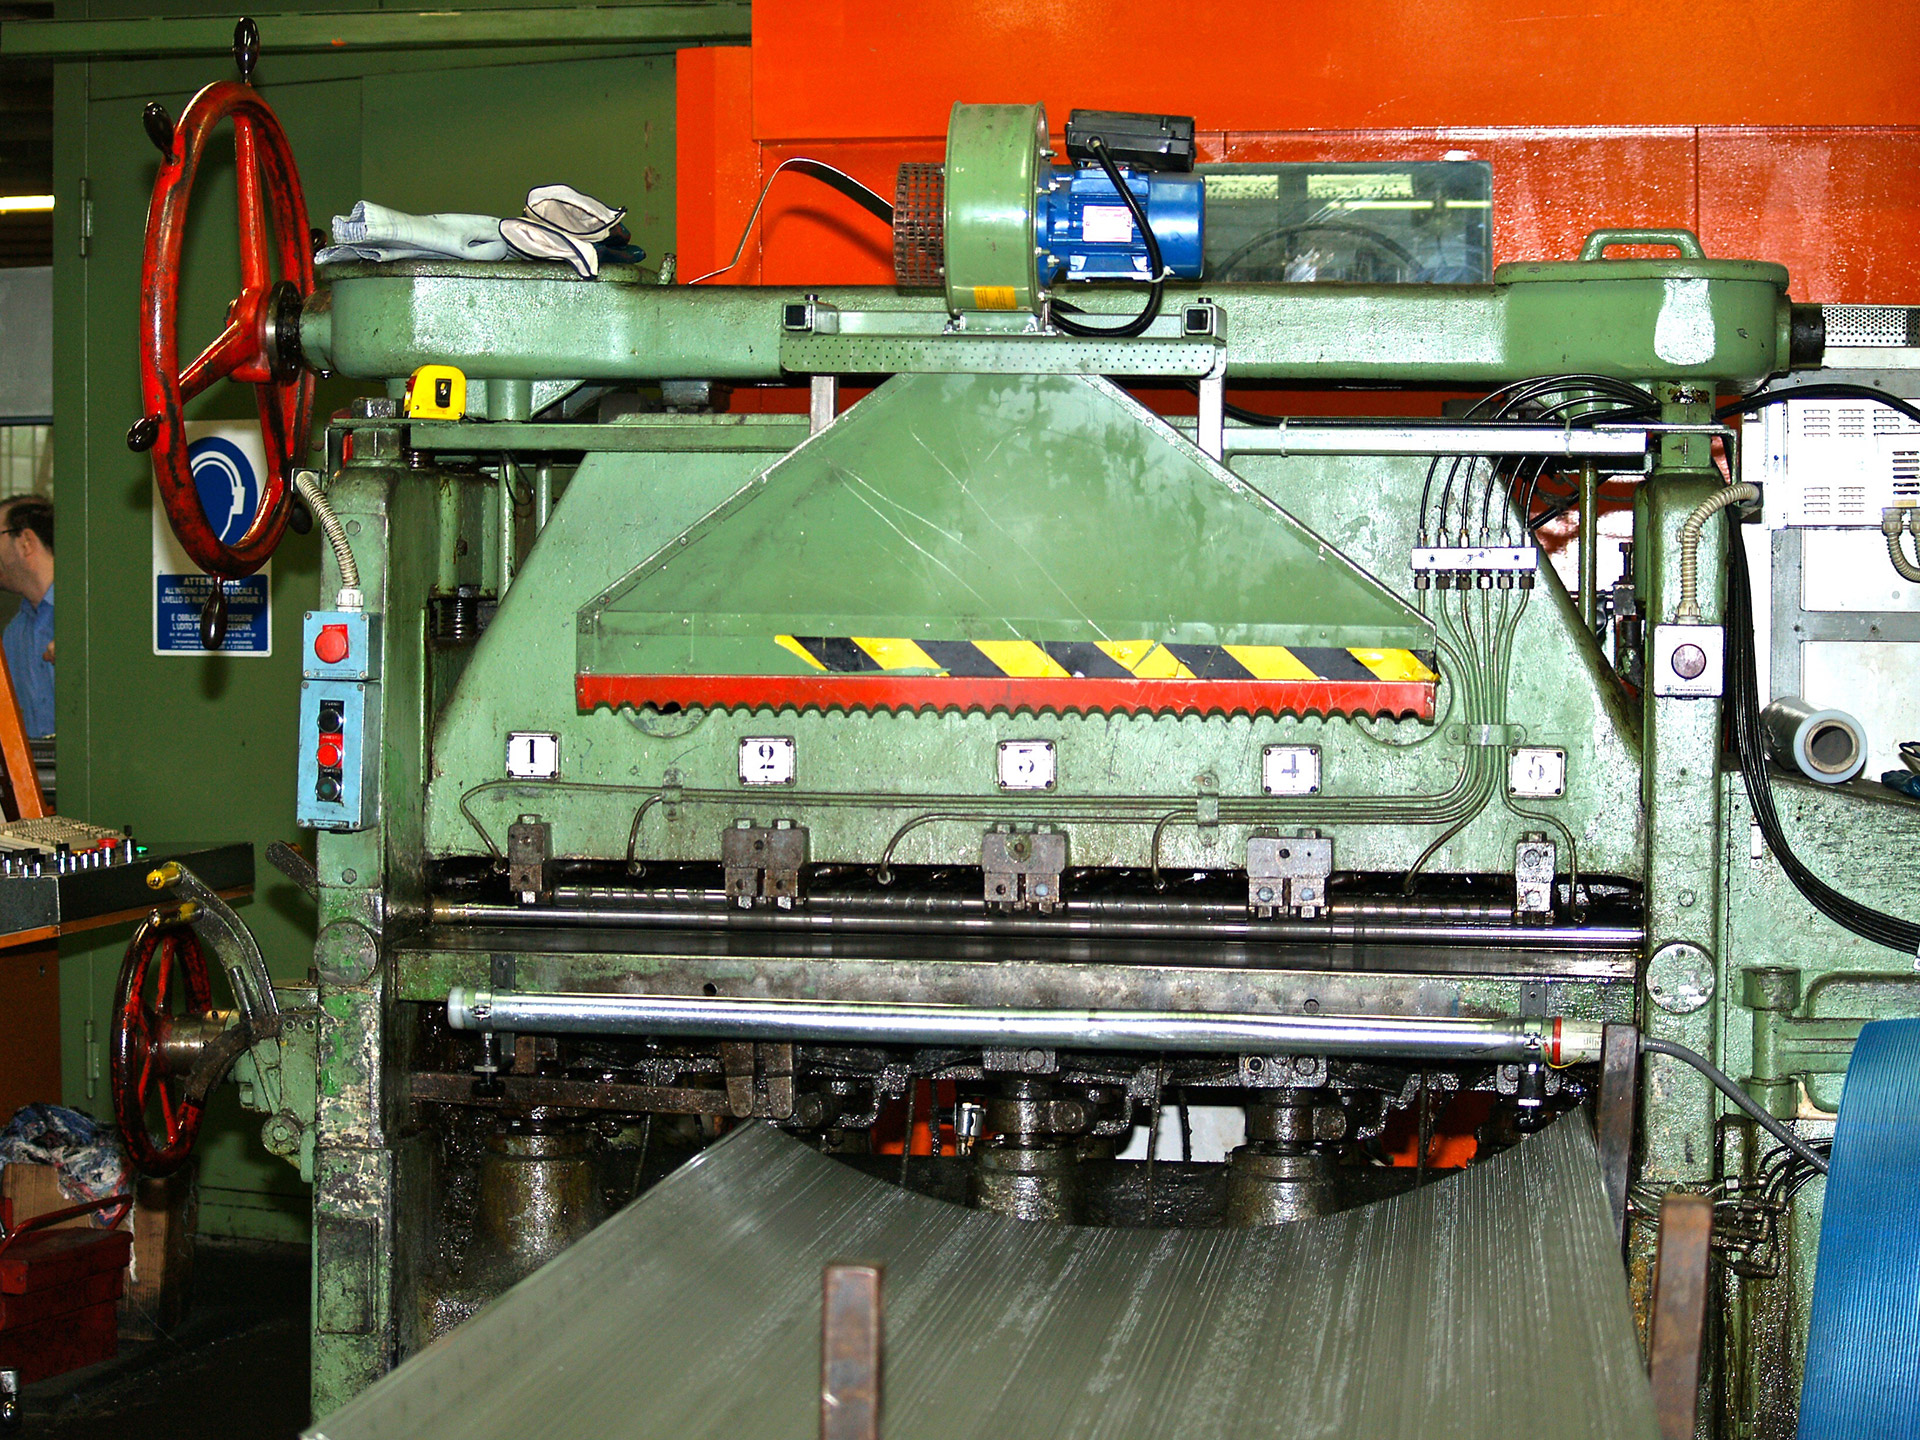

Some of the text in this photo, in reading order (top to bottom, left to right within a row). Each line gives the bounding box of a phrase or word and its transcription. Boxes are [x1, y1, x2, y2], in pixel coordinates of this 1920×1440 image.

[184, 577, 241, 586] ATTENONE
[231, 587, 253, 595] LOCALE
[161, 595, 184, 604] LIVELLO
[172, 622, 193, 631] L'UDITO
[525, 739, 536, 764] 1
[758, 743, 775, 769] 2
[1281, 753, 1300, 778] 4
